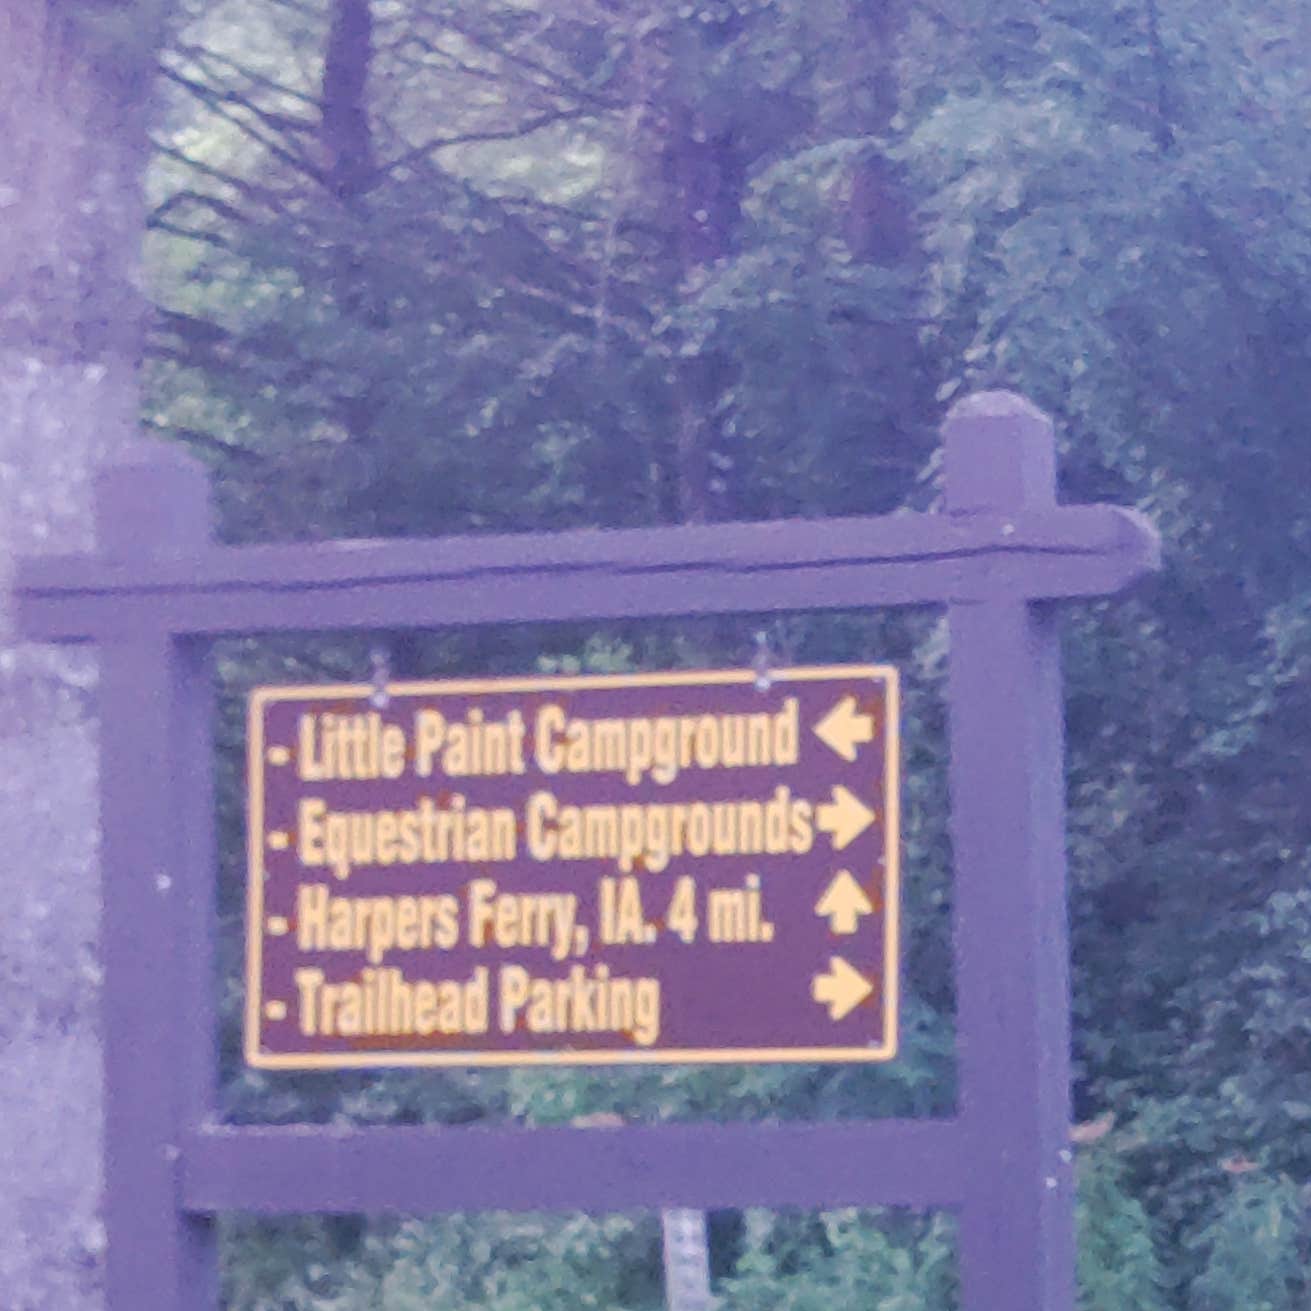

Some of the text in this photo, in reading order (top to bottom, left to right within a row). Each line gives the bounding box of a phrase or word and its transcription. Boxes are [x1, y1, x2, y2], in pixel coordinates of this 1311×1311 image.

[300, 698, 798, 785] Little Paint Campground
[300, 786, 812, 878] Equestrian Campgrounds
[298, 874, 773, 963] Harpers Ferry, IA. 4 mi.
[295, 965, 660, 1045] Trailhead Parking
